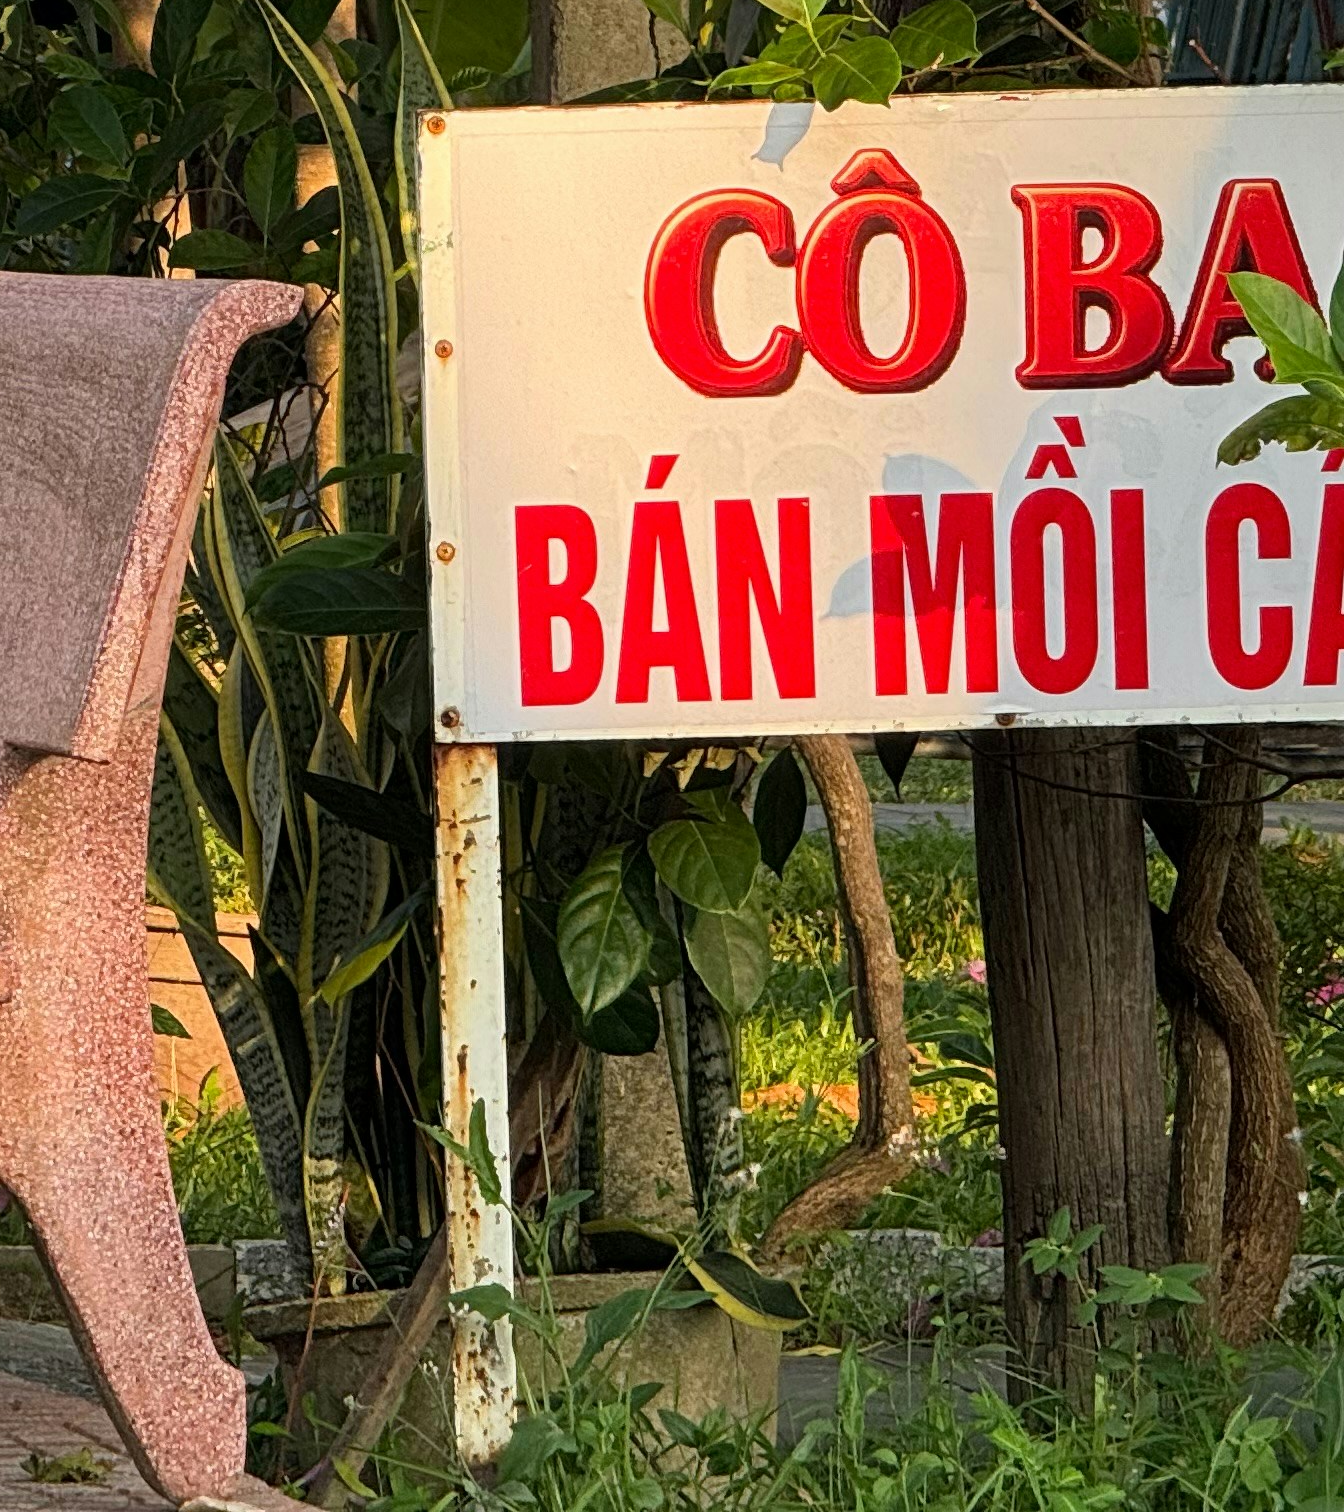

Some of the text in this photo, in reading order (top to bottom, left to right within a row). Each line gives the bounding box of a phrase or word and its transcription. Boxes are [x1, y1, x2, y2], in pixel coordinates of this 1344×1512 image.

[644, 148, 1322, 398] CÔ BA
[514, 454, 817, 707] BÁN
[869, 416, 1151, 696] MỒI
